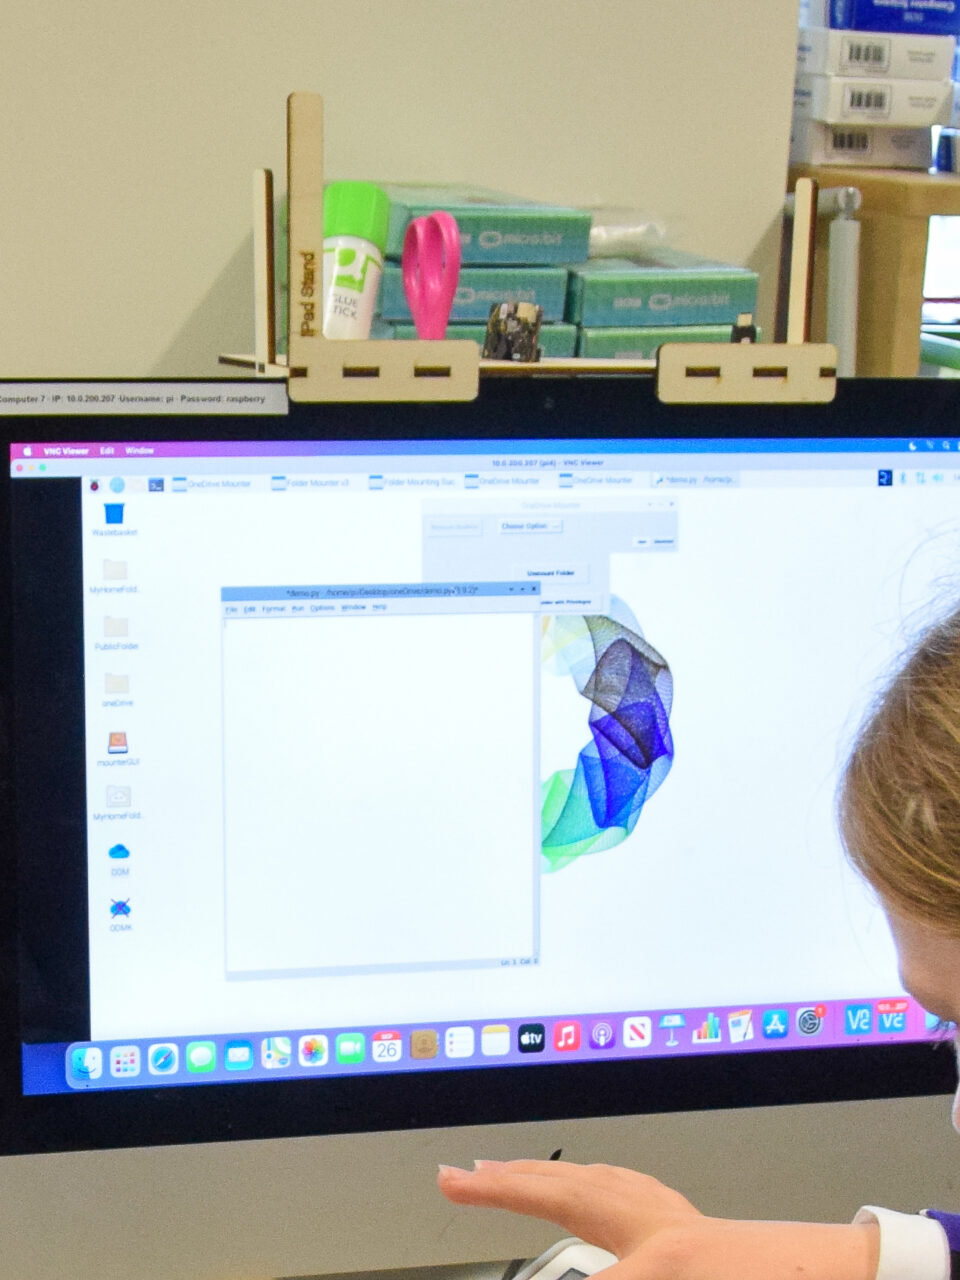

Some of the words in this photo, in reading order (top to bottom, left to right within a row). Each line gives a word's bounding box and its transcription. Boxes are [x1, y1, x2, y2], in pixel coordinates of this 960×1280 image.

[300, 250, 315, 298] Stand
[226, 395, 266, 405] raspberry
[100, 446, 115, 455] Edit
[125, 446, 154, 455] Window
[375, 1042, 398, 1059] 26
